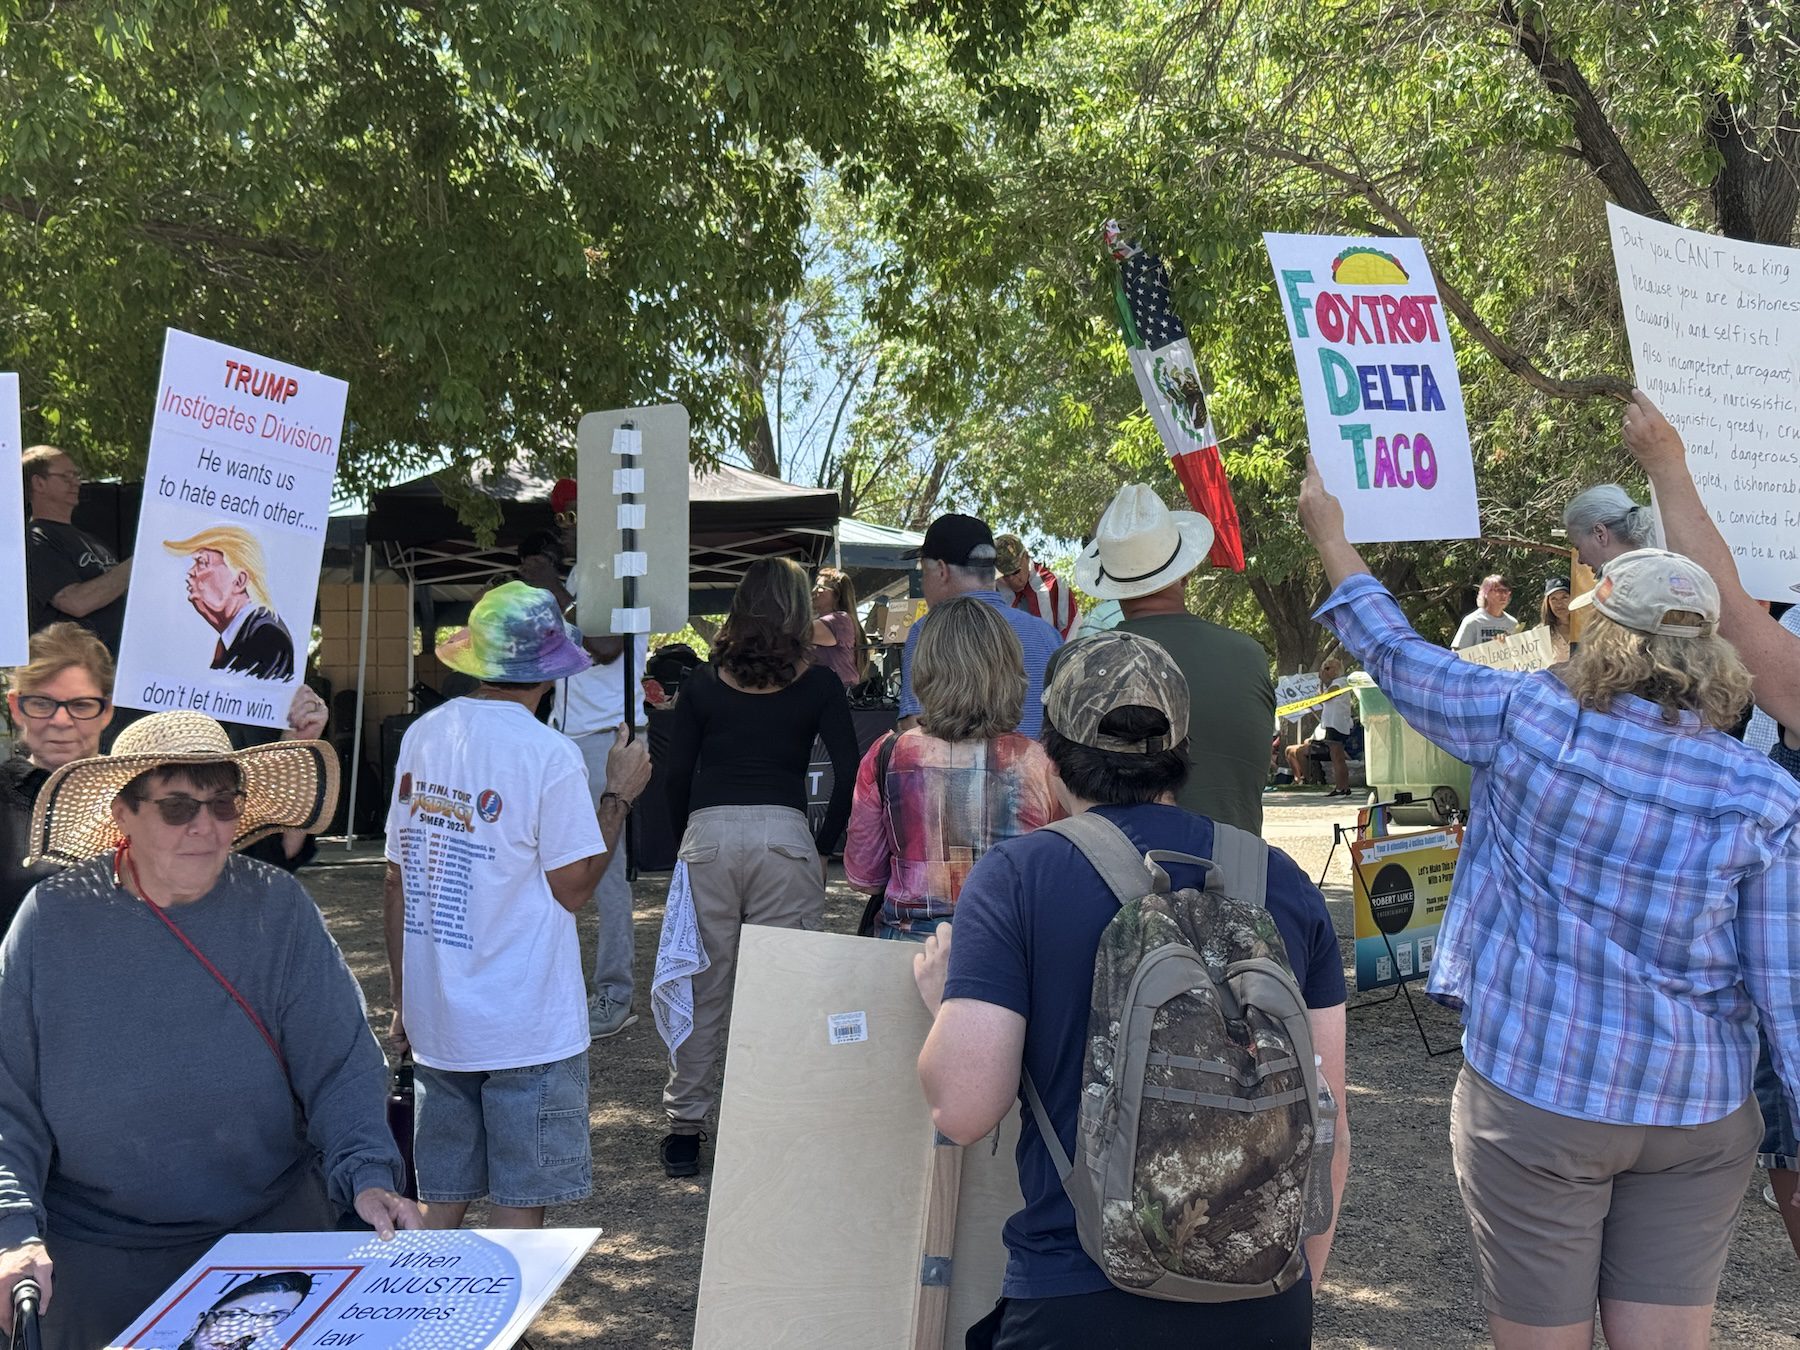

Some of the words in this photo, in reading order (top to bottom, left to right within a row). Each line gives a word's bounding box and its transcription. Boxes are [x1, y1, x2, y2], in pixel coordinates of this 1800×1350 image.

[1620, 226, 1644, 249] But
[1650, 242, 1672, 264] you
[1675, 238, 1725, 269] CAN'T
[1733, 256, 1744, 274] be
[1748, 264, 1756, 274] a
[1630, 264, 1672, 298] because
[1677, 284, 1698, 310] you
[1706, 292, 1728, 306] are
[1736, 290, 1800, 312] dishones
[1281, 270, 1440, 346] FOXTROT
[1688, 324, 1710, 339] and
[1642, 342, 1662, 364] Also
[1668, 354, 1733, 380] incompetent,
[1736, 363, 1792, 384] arrogant,
[224, 360, 299, 405] TRUMP
[1318, 347, 1446, 416] DELTA
[1646, 376, 1716, 405] unqualified,
[1722, 393, 1796, 412] narcissistic,
[162, 386, 256, 435] Instigates
[260, 414, 336, 457] Division.
[1665, 412, 1722, 432] sogynistic,
[1727, 419, 1768, 441] greedy,
[1338, 424, 1438, 490] TACO
[1687, 440, 1718, 459] ional,
[198, 448, 222, 474] He
[226, 460, 272, 486] wants
[276, 471, 296, 492] us
[1694, 472, 1727, 492] cipled,
[1734, 474, 1800, 494] dishonorab
[159, 475, 176, 498] to
[180, 482, 216, 510] hate
[220, 490, 258, 518] each
[1730, 509, 1776, 526] convicted
[1752, 540, 1764, 558] be
[1767, 548, 1774, 558] a
[1488, 646, 1520, 664] LEADERS
[1521, 640, 1540, 656] NOT
[143, 681, 186, 709] don't
[190, 688, 208, 712] let
[212, 692, 242, 716] him
[246, 699, 275, 721] win.
[1372, 894, 1396, 906] ROBERT
[1397, 892, 1413, 902] LUKE
[389, 1252, 462, 1269] When
[215, 1273, 333, 1295] TE
[362, 1277, 514, 1294] INJUSTICE
[338, 1302, 456, 1320] becomes
[312, 1329, 364, 1346] law
